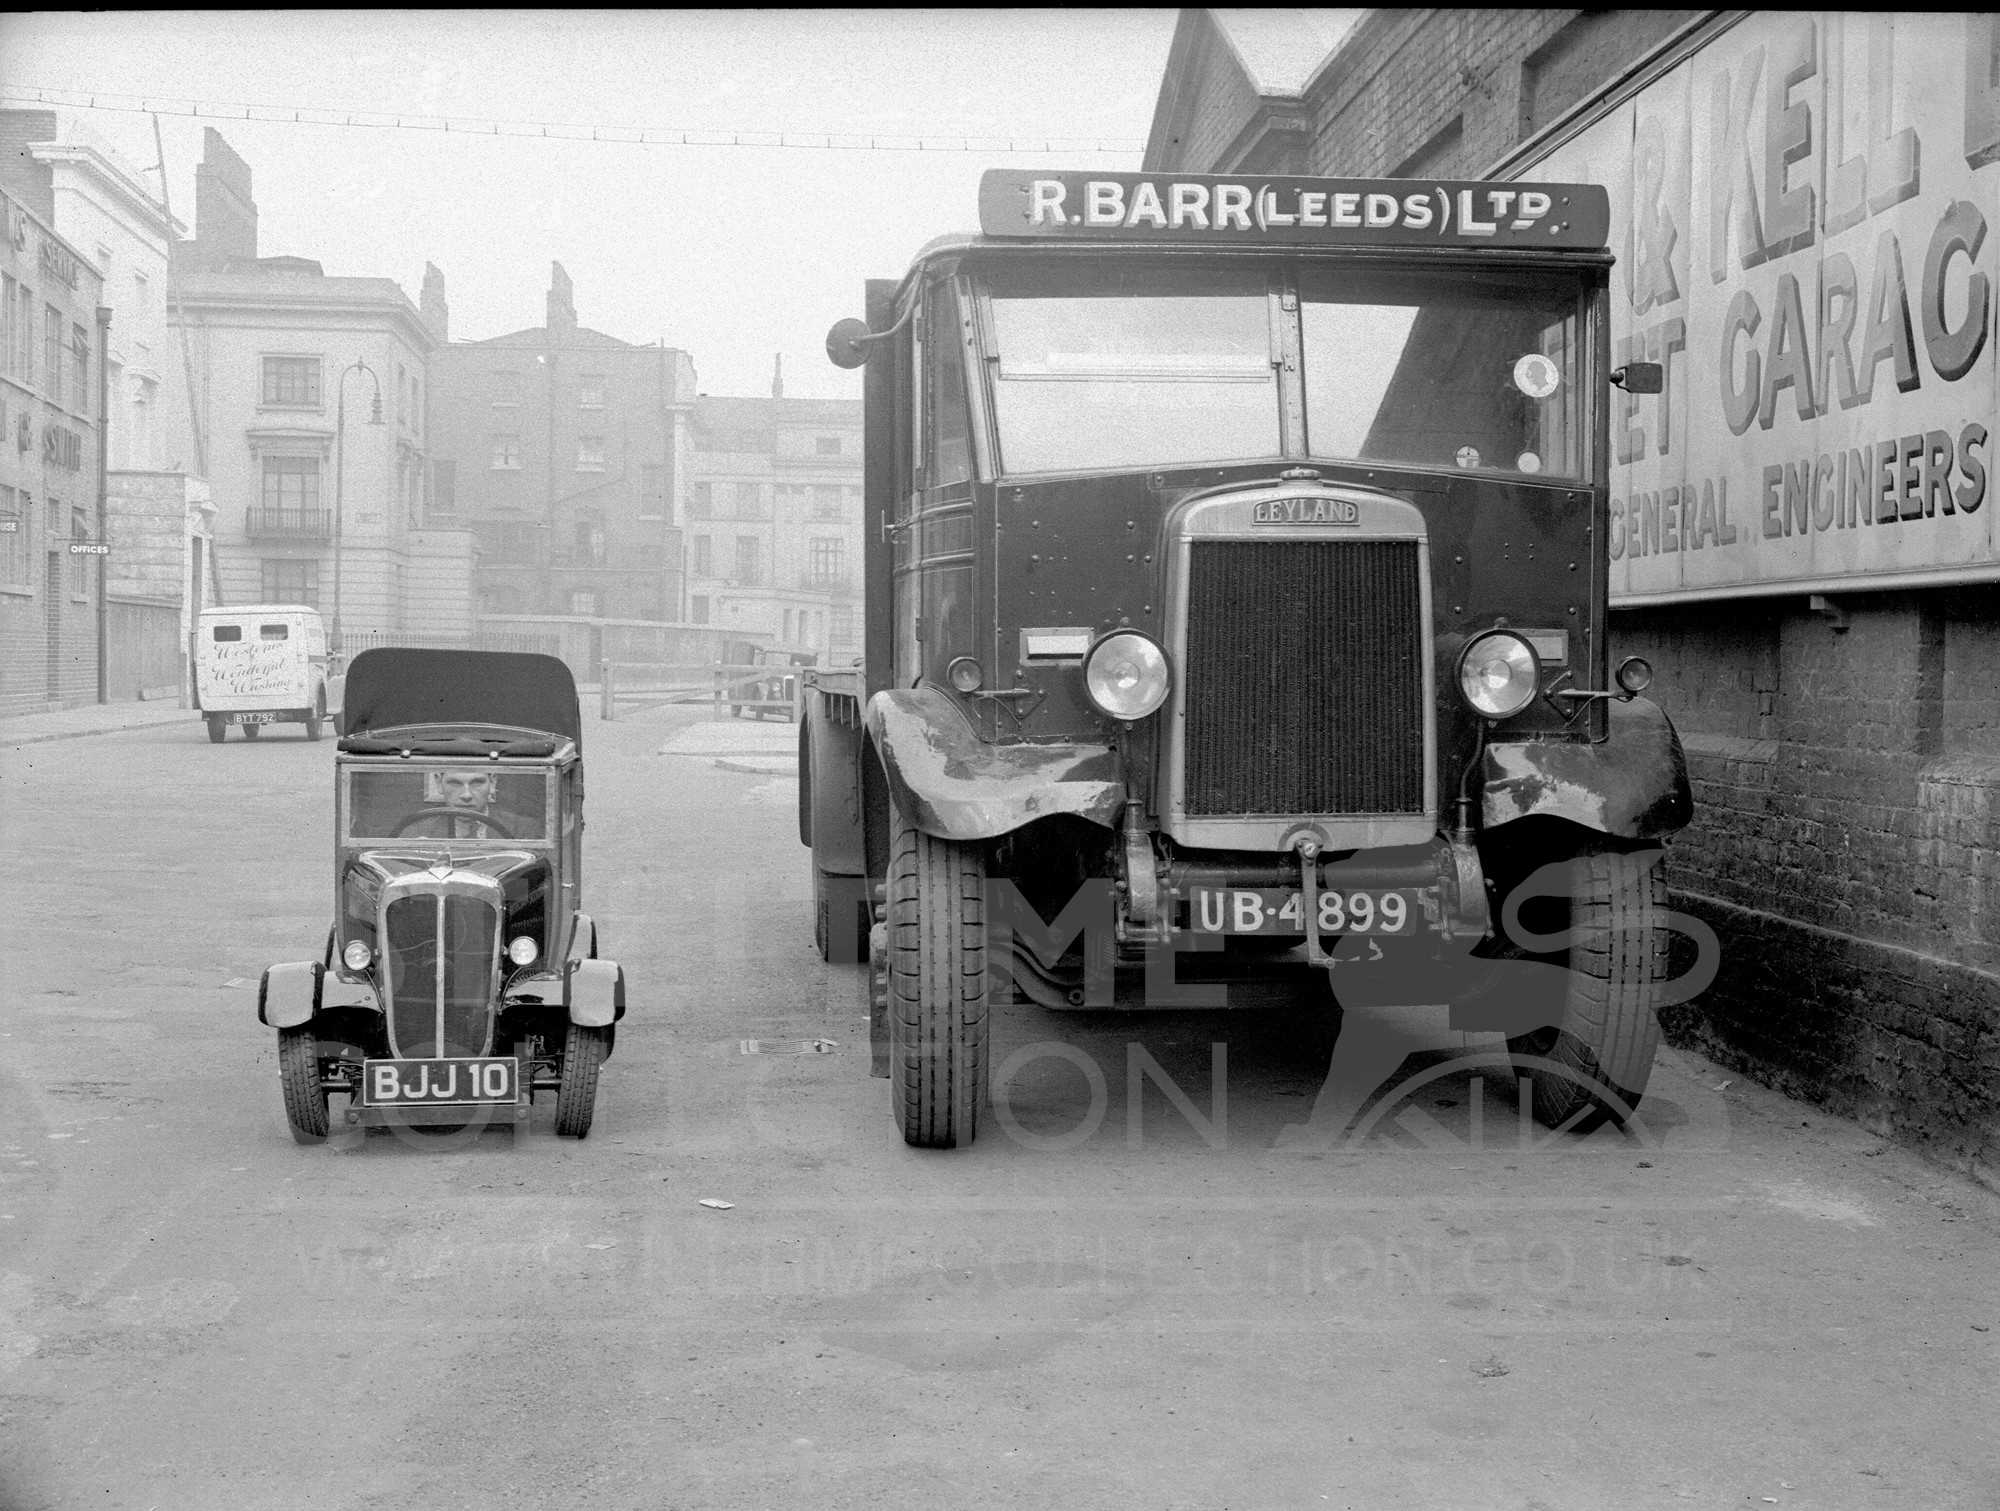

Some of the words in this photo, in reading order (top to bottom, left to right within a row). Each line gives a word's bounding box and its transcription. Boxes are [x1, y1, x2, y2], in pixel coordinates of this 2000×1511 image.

[1609, 316, 1686, 468] ET
[1609, 476, 1738, 561] GENERAL
[1762, 423, 1988, 540] ENGINEERS
[1255, 498, 1357, 523] LEYLAND
[71, 545, 109, 554] OFFICES
[374, 1064, 457, 1099] BJJ
[468, 1063, 509, 1098] 10
